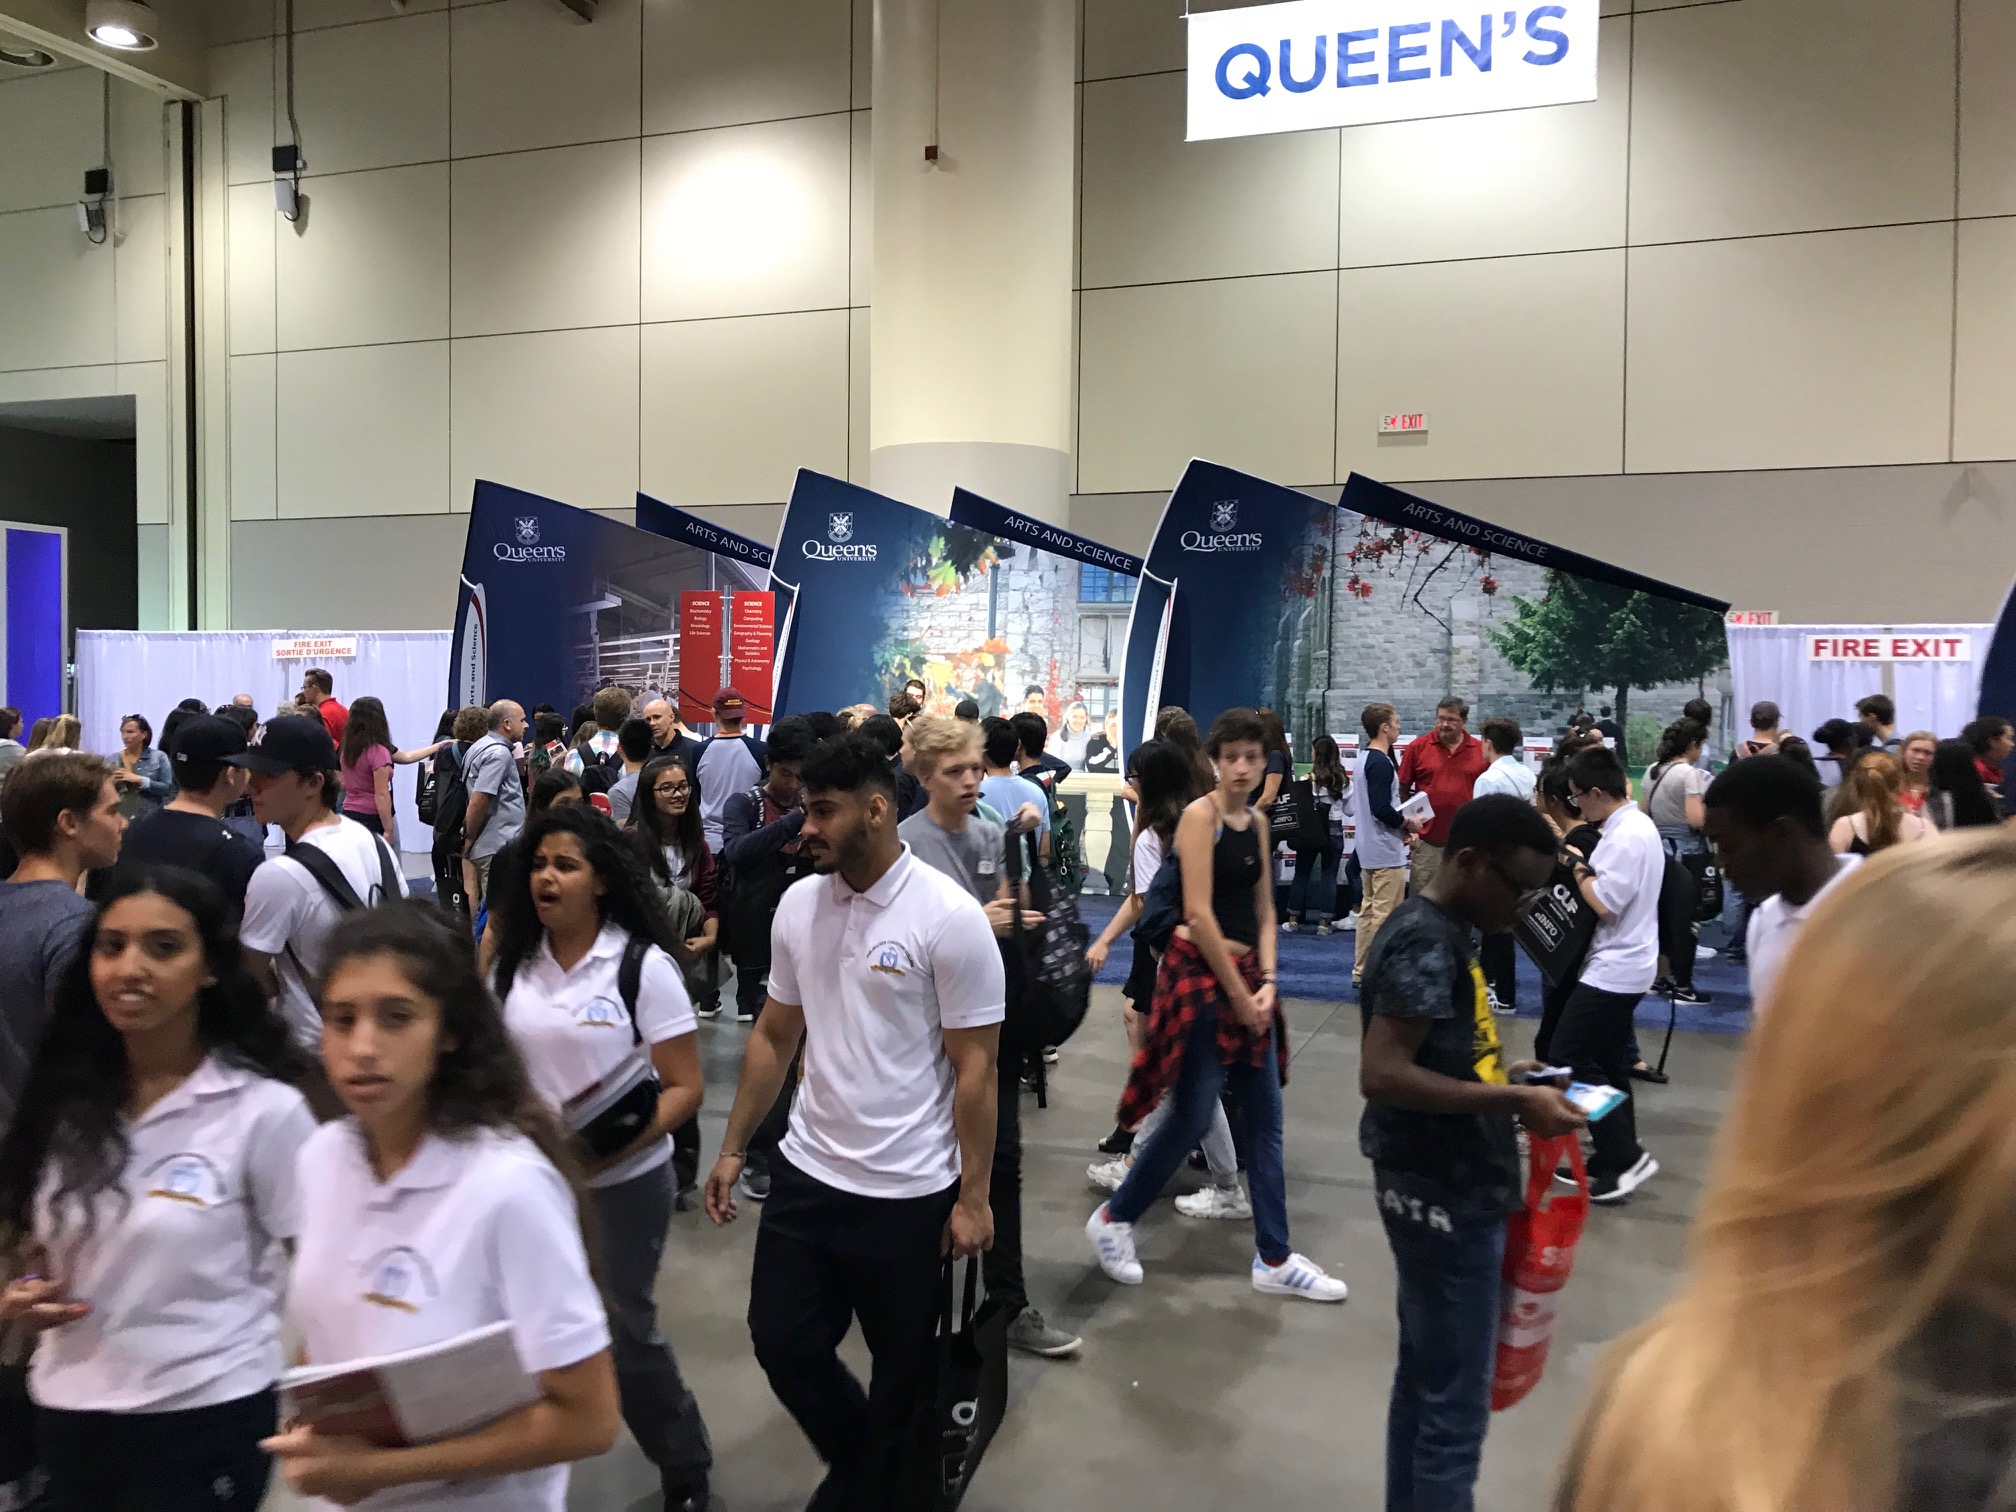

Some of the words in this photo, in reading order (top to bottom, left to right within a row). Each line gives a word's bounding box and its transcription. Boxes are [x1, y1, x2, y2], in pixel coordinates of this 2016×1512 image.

[1215, 5, 1570, 100] QUEEN'S
[1402, 414, 1423, 430] EXIT
[686, 522, 717, 542] ARTS
[720, 537, 748, 554] AND
[1180, 530, 1262, 552] Queen's
[1403, 503, 1443, 523] ARTS
[1444, 518, 1480, 536] AND
[1482, 530, 1548, 558] SCIENCE
[493, 543, 566, 562] Queen's
[802, 540, 878, 560] Queen's
[1004, 516, 1040, 536] ARTS
[1041, 530, 1073, 548] AND
[1075, 542, 1132, 570] SCIENCE
[1814, 639, 1880, 657] FIRE
[1891, 638, 1962, 657] EXIT
